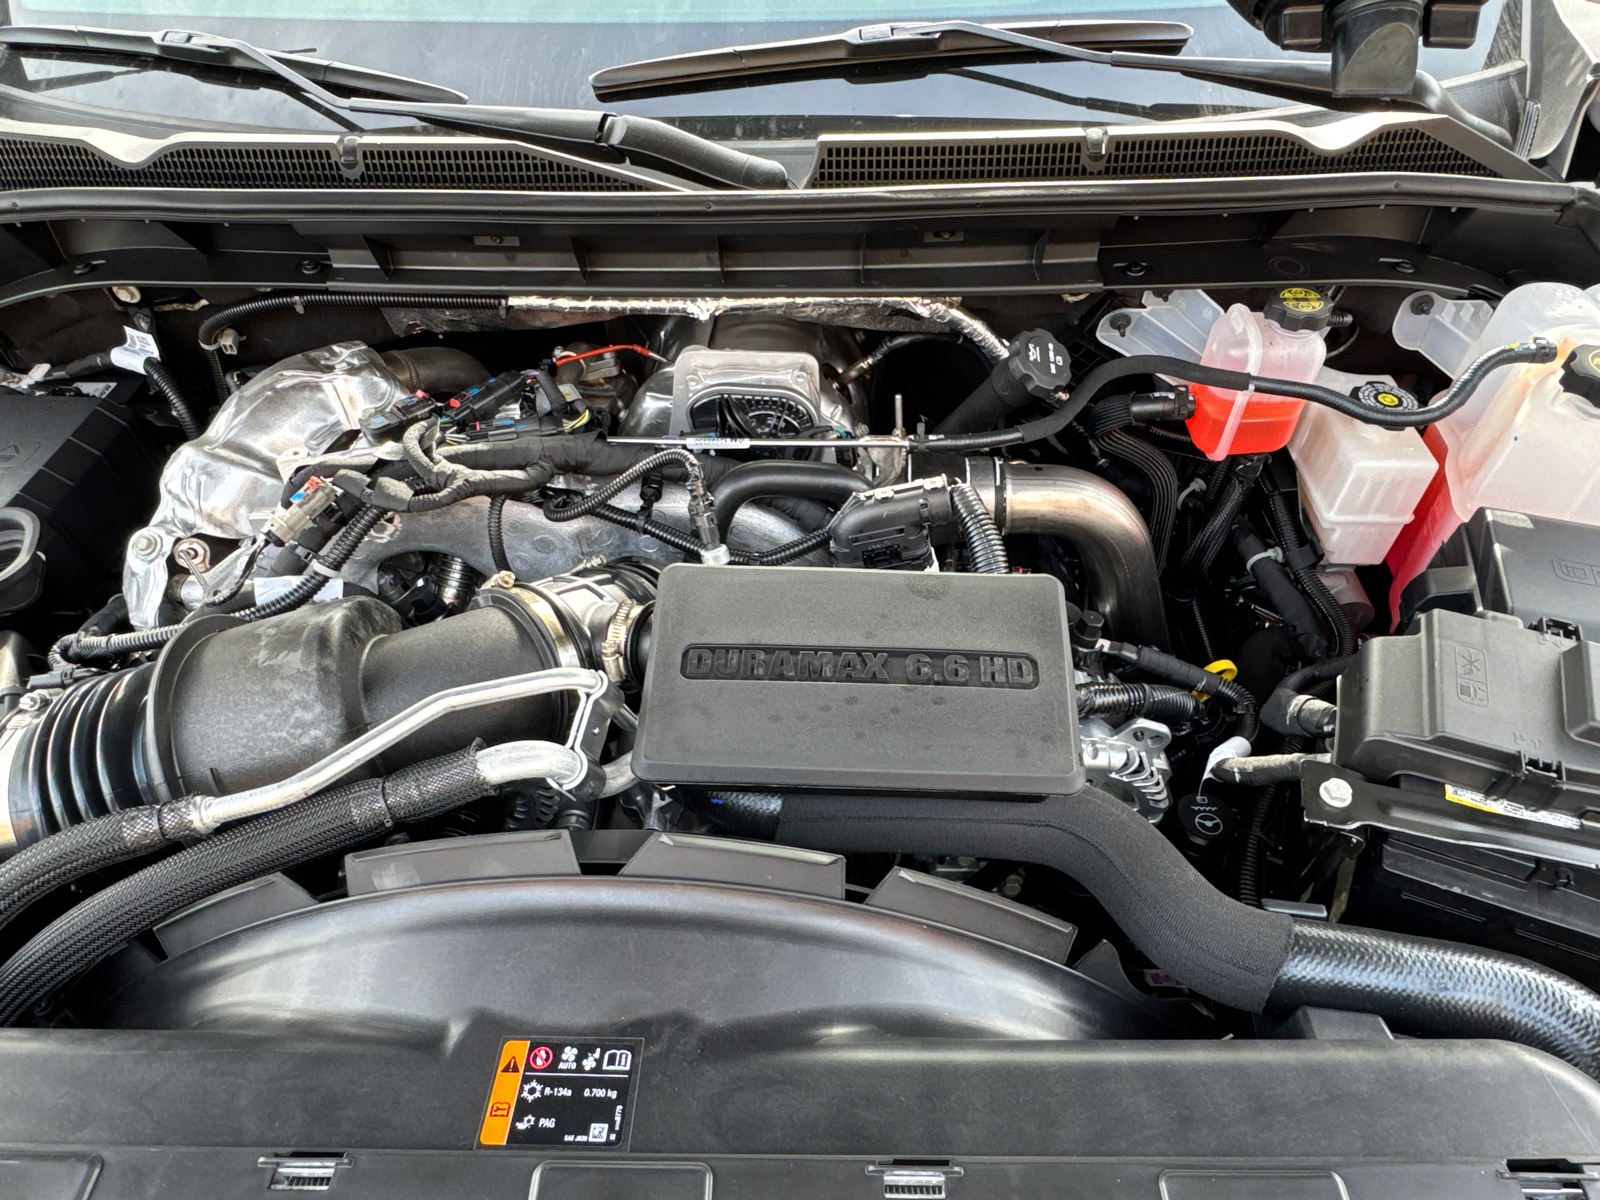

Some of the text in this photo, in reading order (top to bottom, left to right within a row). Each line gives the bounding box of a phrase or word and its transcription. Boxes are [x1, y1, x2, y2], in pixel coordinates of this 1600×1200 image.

[686, 648, 1034, 686] DURAMAX 6.6 HD
[544, 1087, 572, 1096] R-134a
[584, 1088, 618, 1100] 0.700 kg
[538, 1118, 556, 1128] PAG
